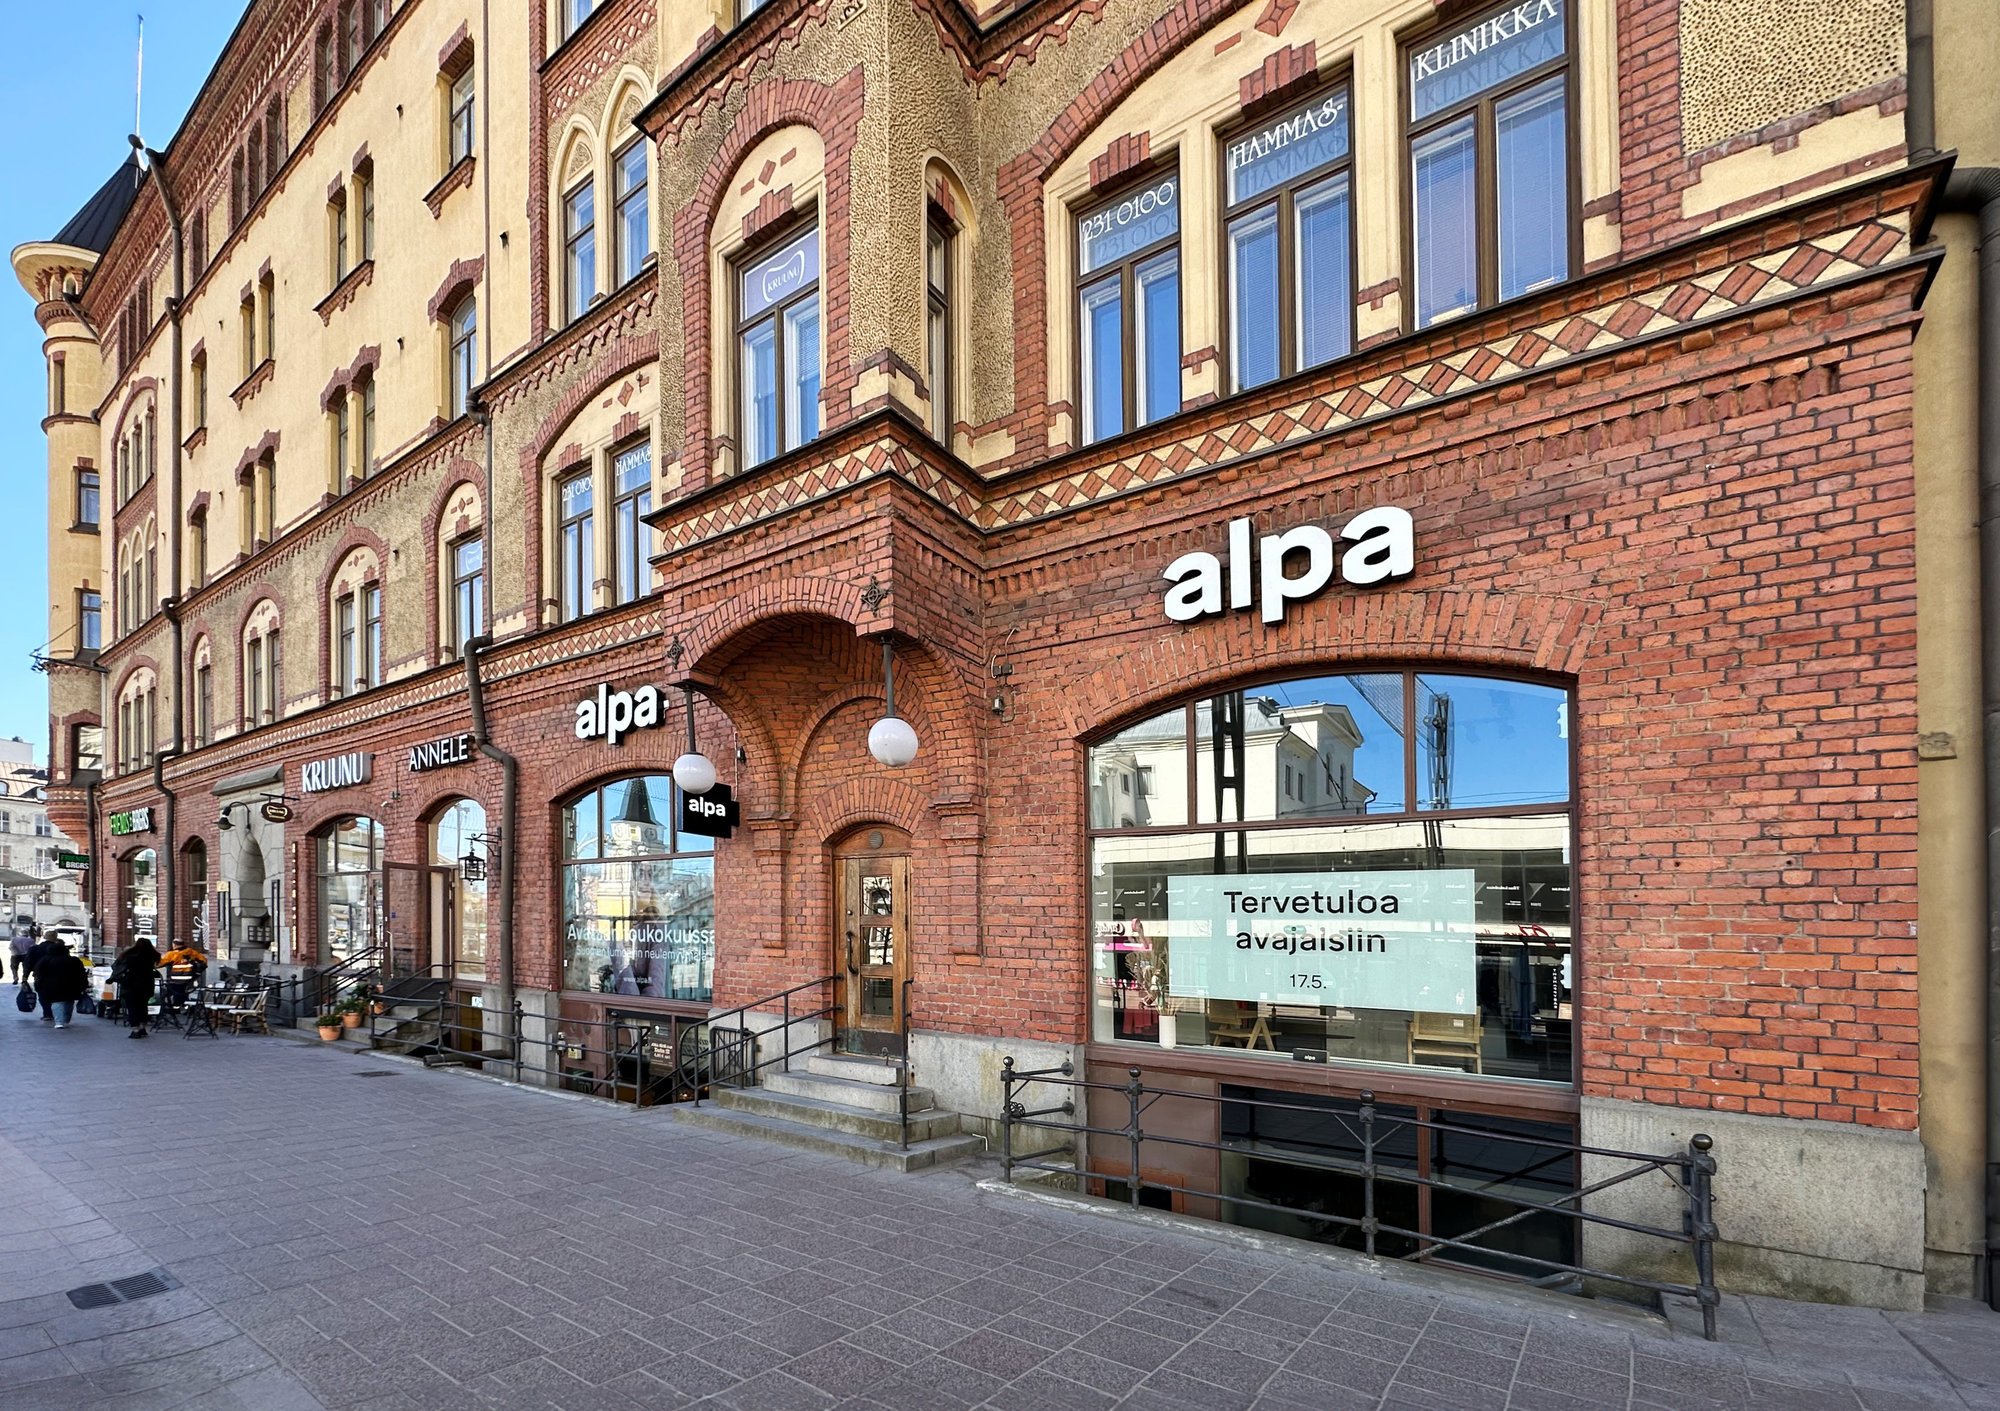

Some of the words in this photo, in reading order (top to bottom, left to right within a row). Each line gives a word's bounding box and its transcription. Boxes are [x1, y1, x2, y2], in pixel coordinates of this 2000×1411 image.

[1415, 0, 1558, 82] KLINIKKA
[1082, 211, 1113, 243] 231
[1116, 182, 1174, 226] 0100
[1162, 506, 1415, 624] alpa
[575, 683, 658, 745] alpa
[302, 751, 364, 793] KRUUNU
[408, 735, 468, 772] ANNELE
[688, 797, 726, 818] alpa
[1223, 889, 1399, 914] Tervetuloa
[1236, 925, 1386, 955] avajaisiin
[1289, 974, 1327, 989] 17.5.
